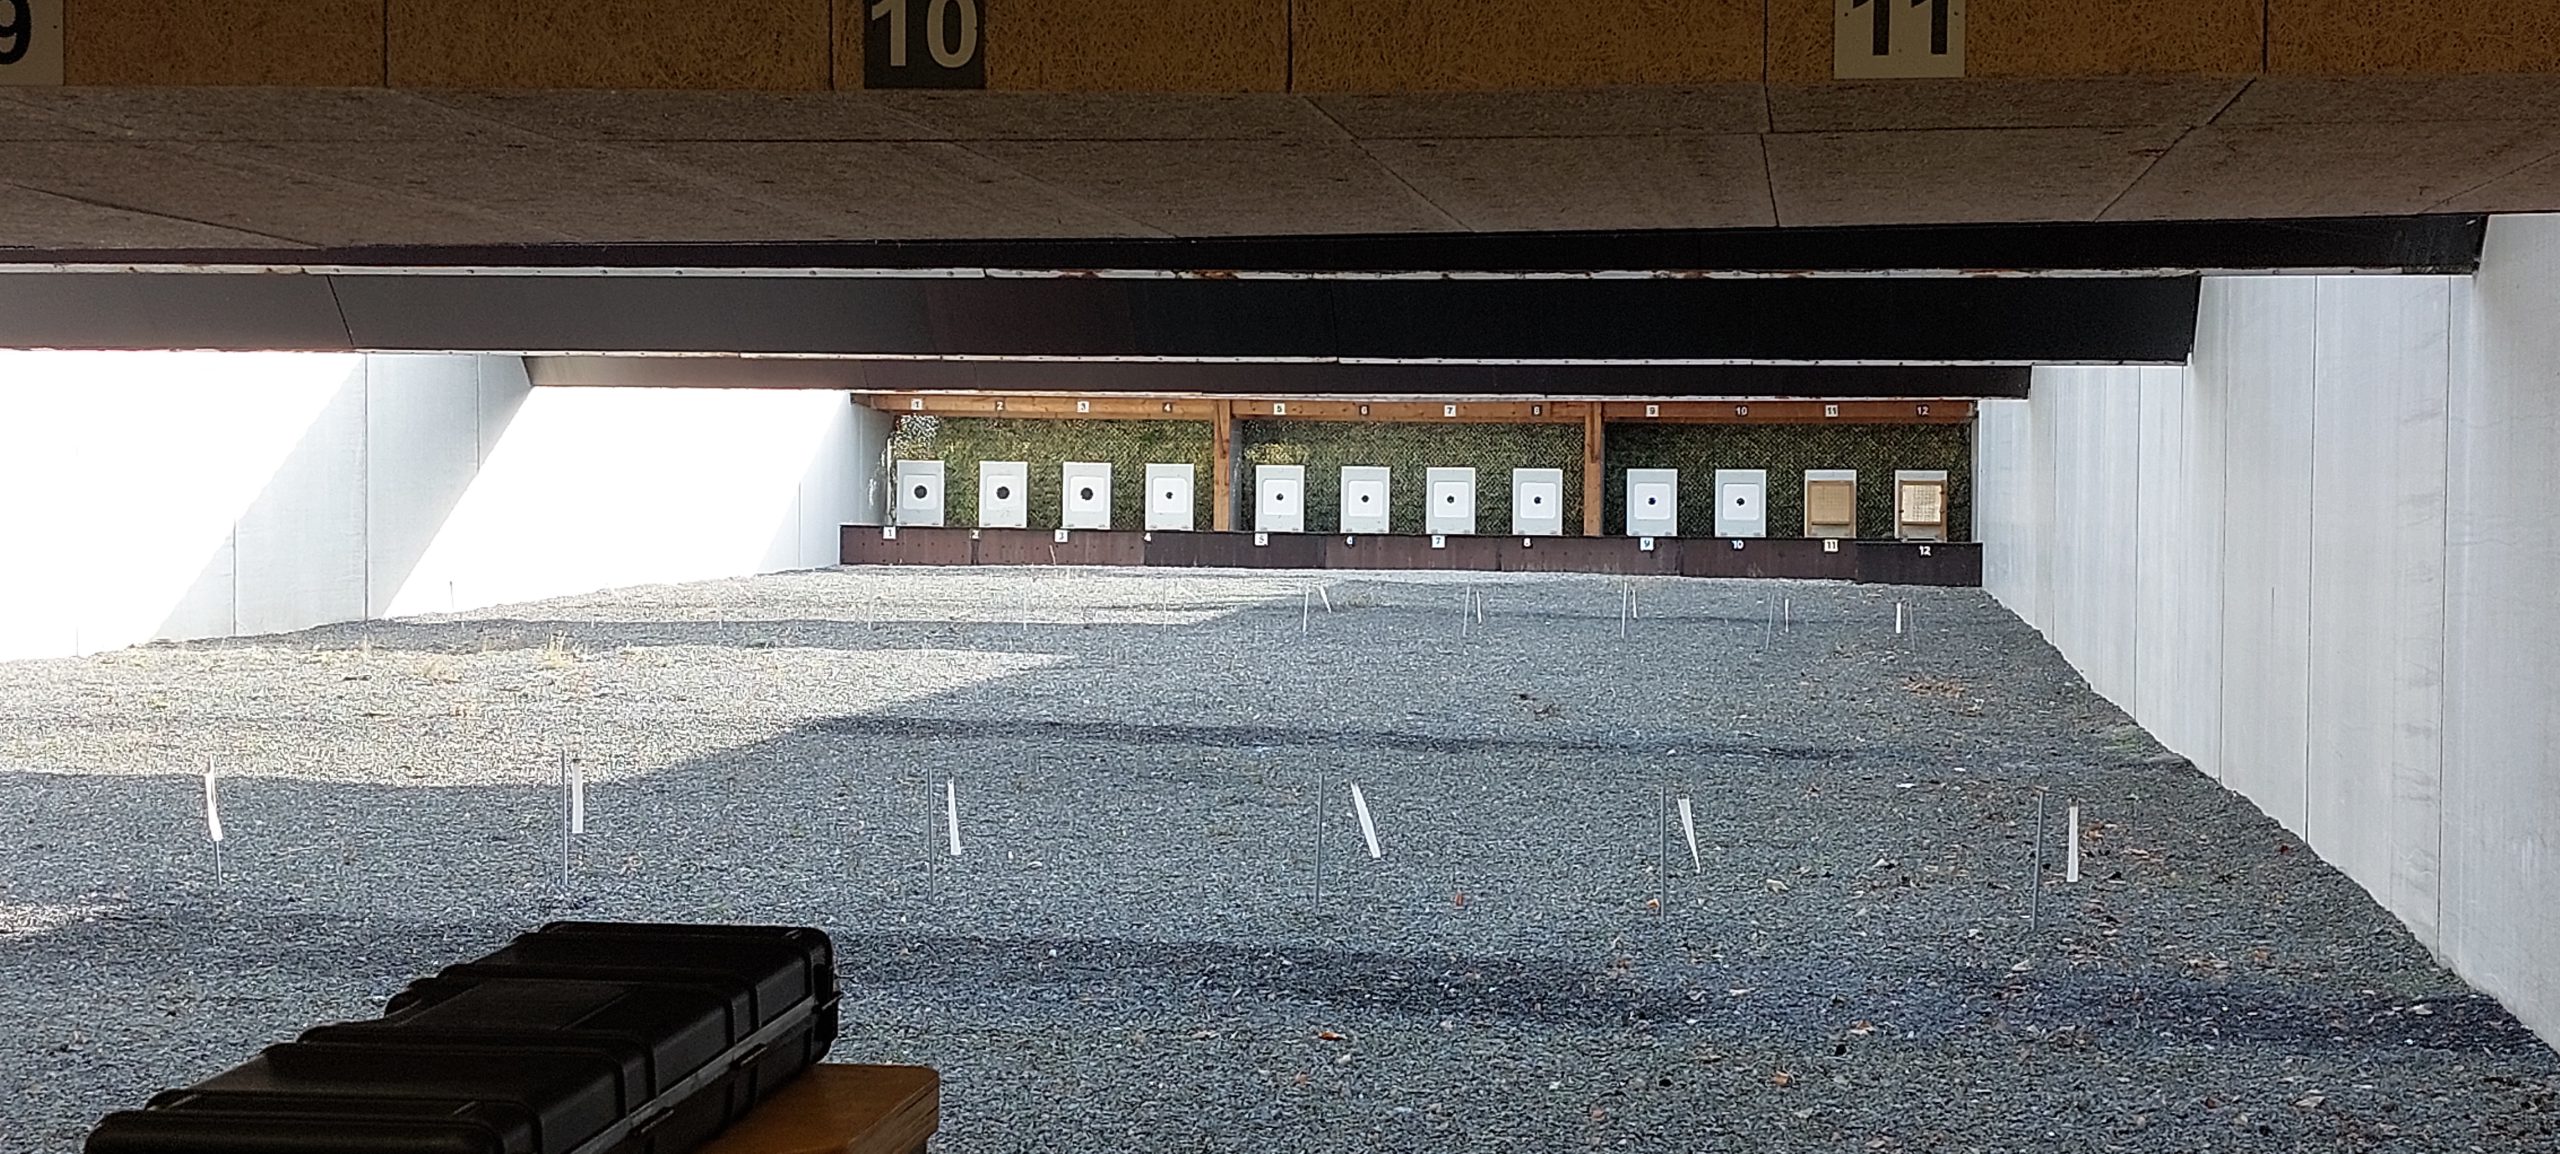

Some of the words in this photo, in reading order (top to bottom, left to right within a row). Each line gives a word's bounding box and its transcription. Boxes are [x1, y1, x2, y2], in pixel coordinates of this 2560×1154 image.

[1853, 0, 1948, 55] 11
[872, 0, 977, 68] 10
[1736, 406, 1748, 416] 10
[1916, 406, 1929, 416] 12
[1732, 540, 1744, 550] 10
[1919, 545, 1932, 556] 12
